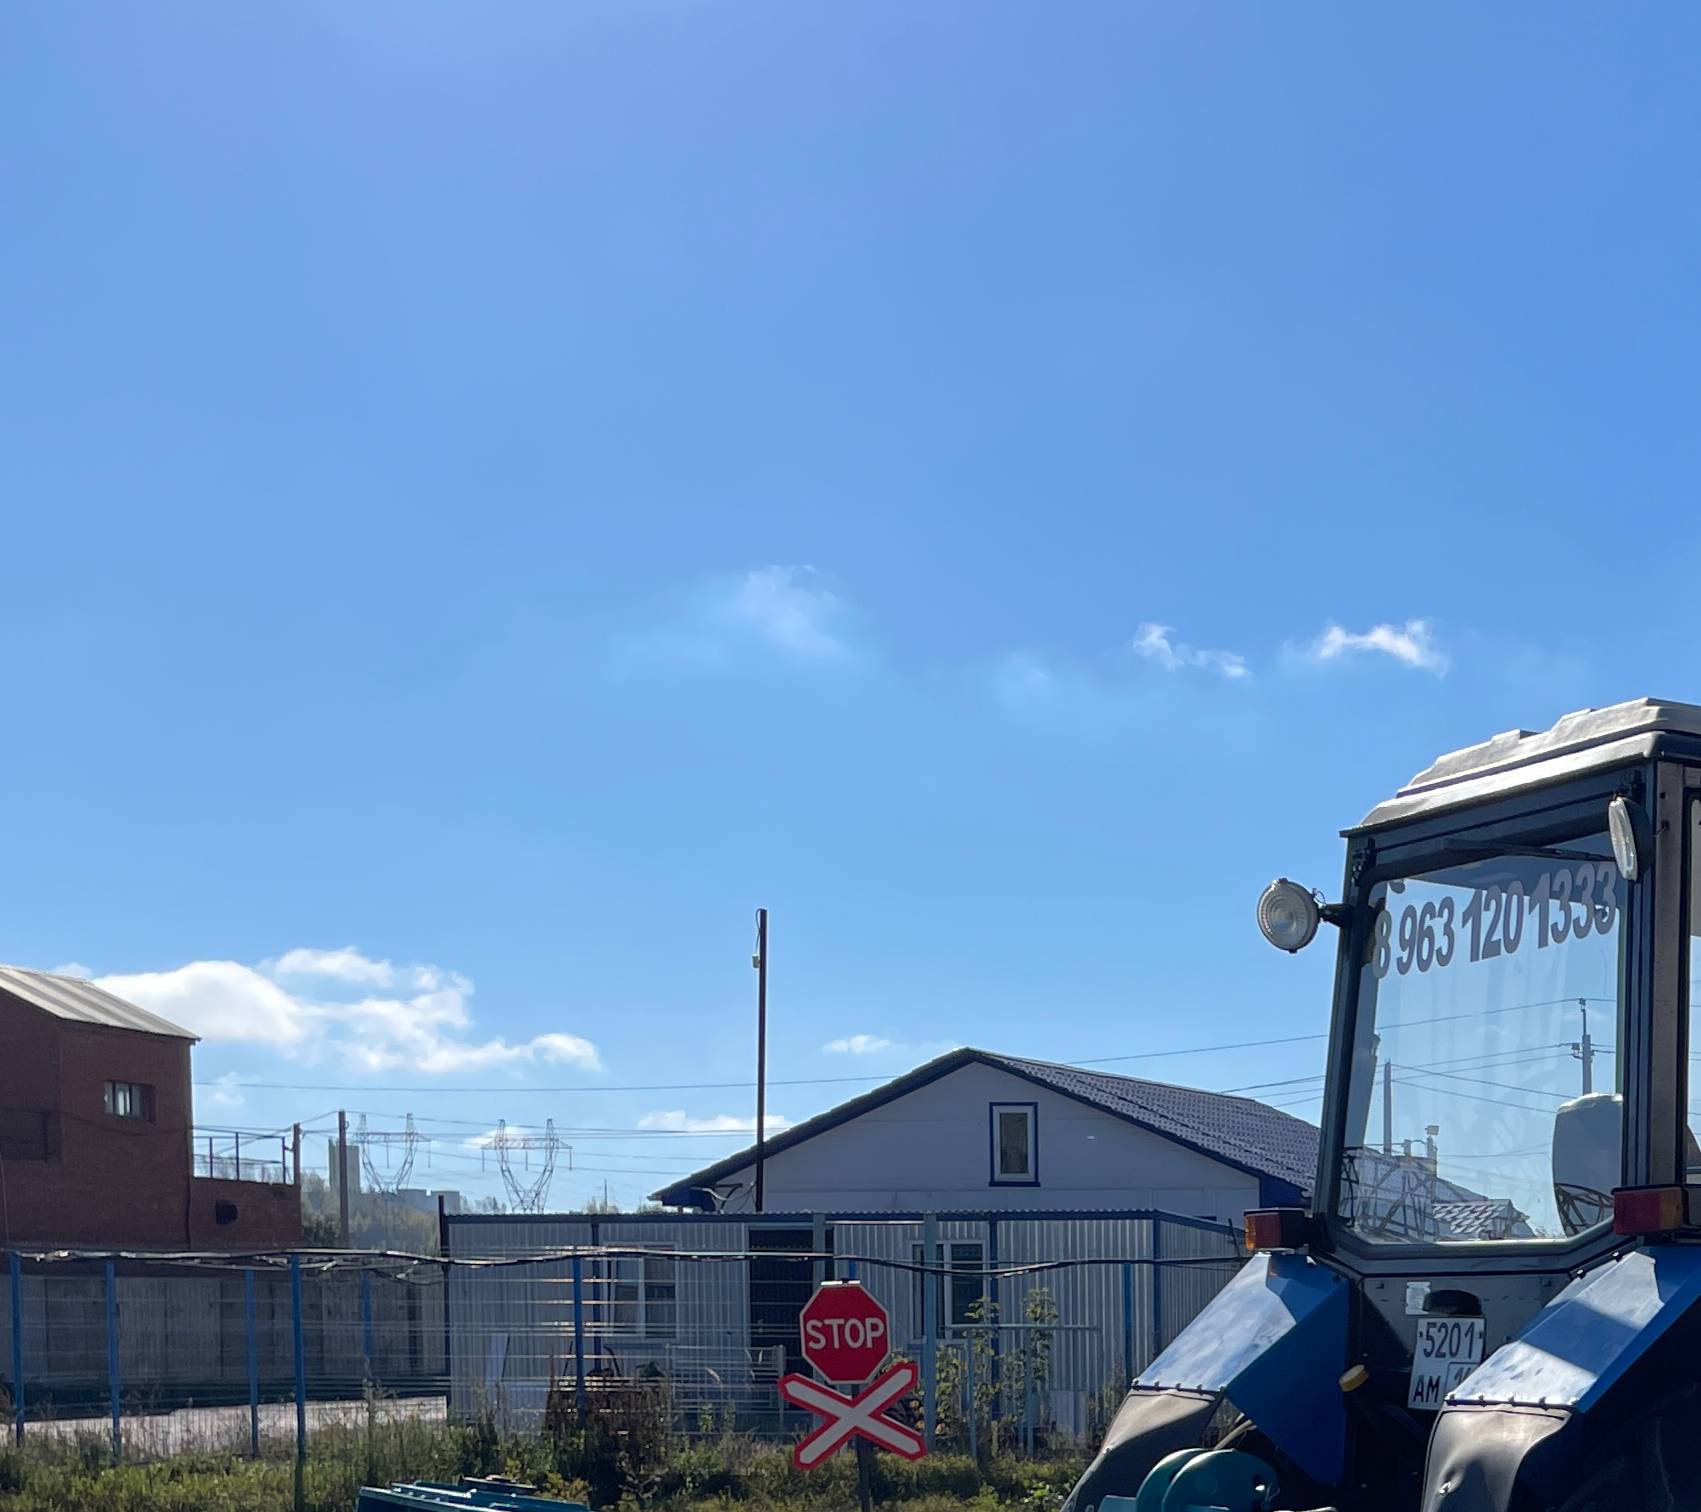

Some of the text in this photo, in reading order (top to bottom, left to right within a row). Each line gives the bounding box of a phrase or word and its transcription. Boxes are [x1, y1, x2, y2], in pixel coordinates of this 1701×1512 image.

[1372, 863, 1616, 979] 8 963 120 1333
[806, 1318, 885, 1350] STOP
[1423, 1322, 1475, 1359] 5201
